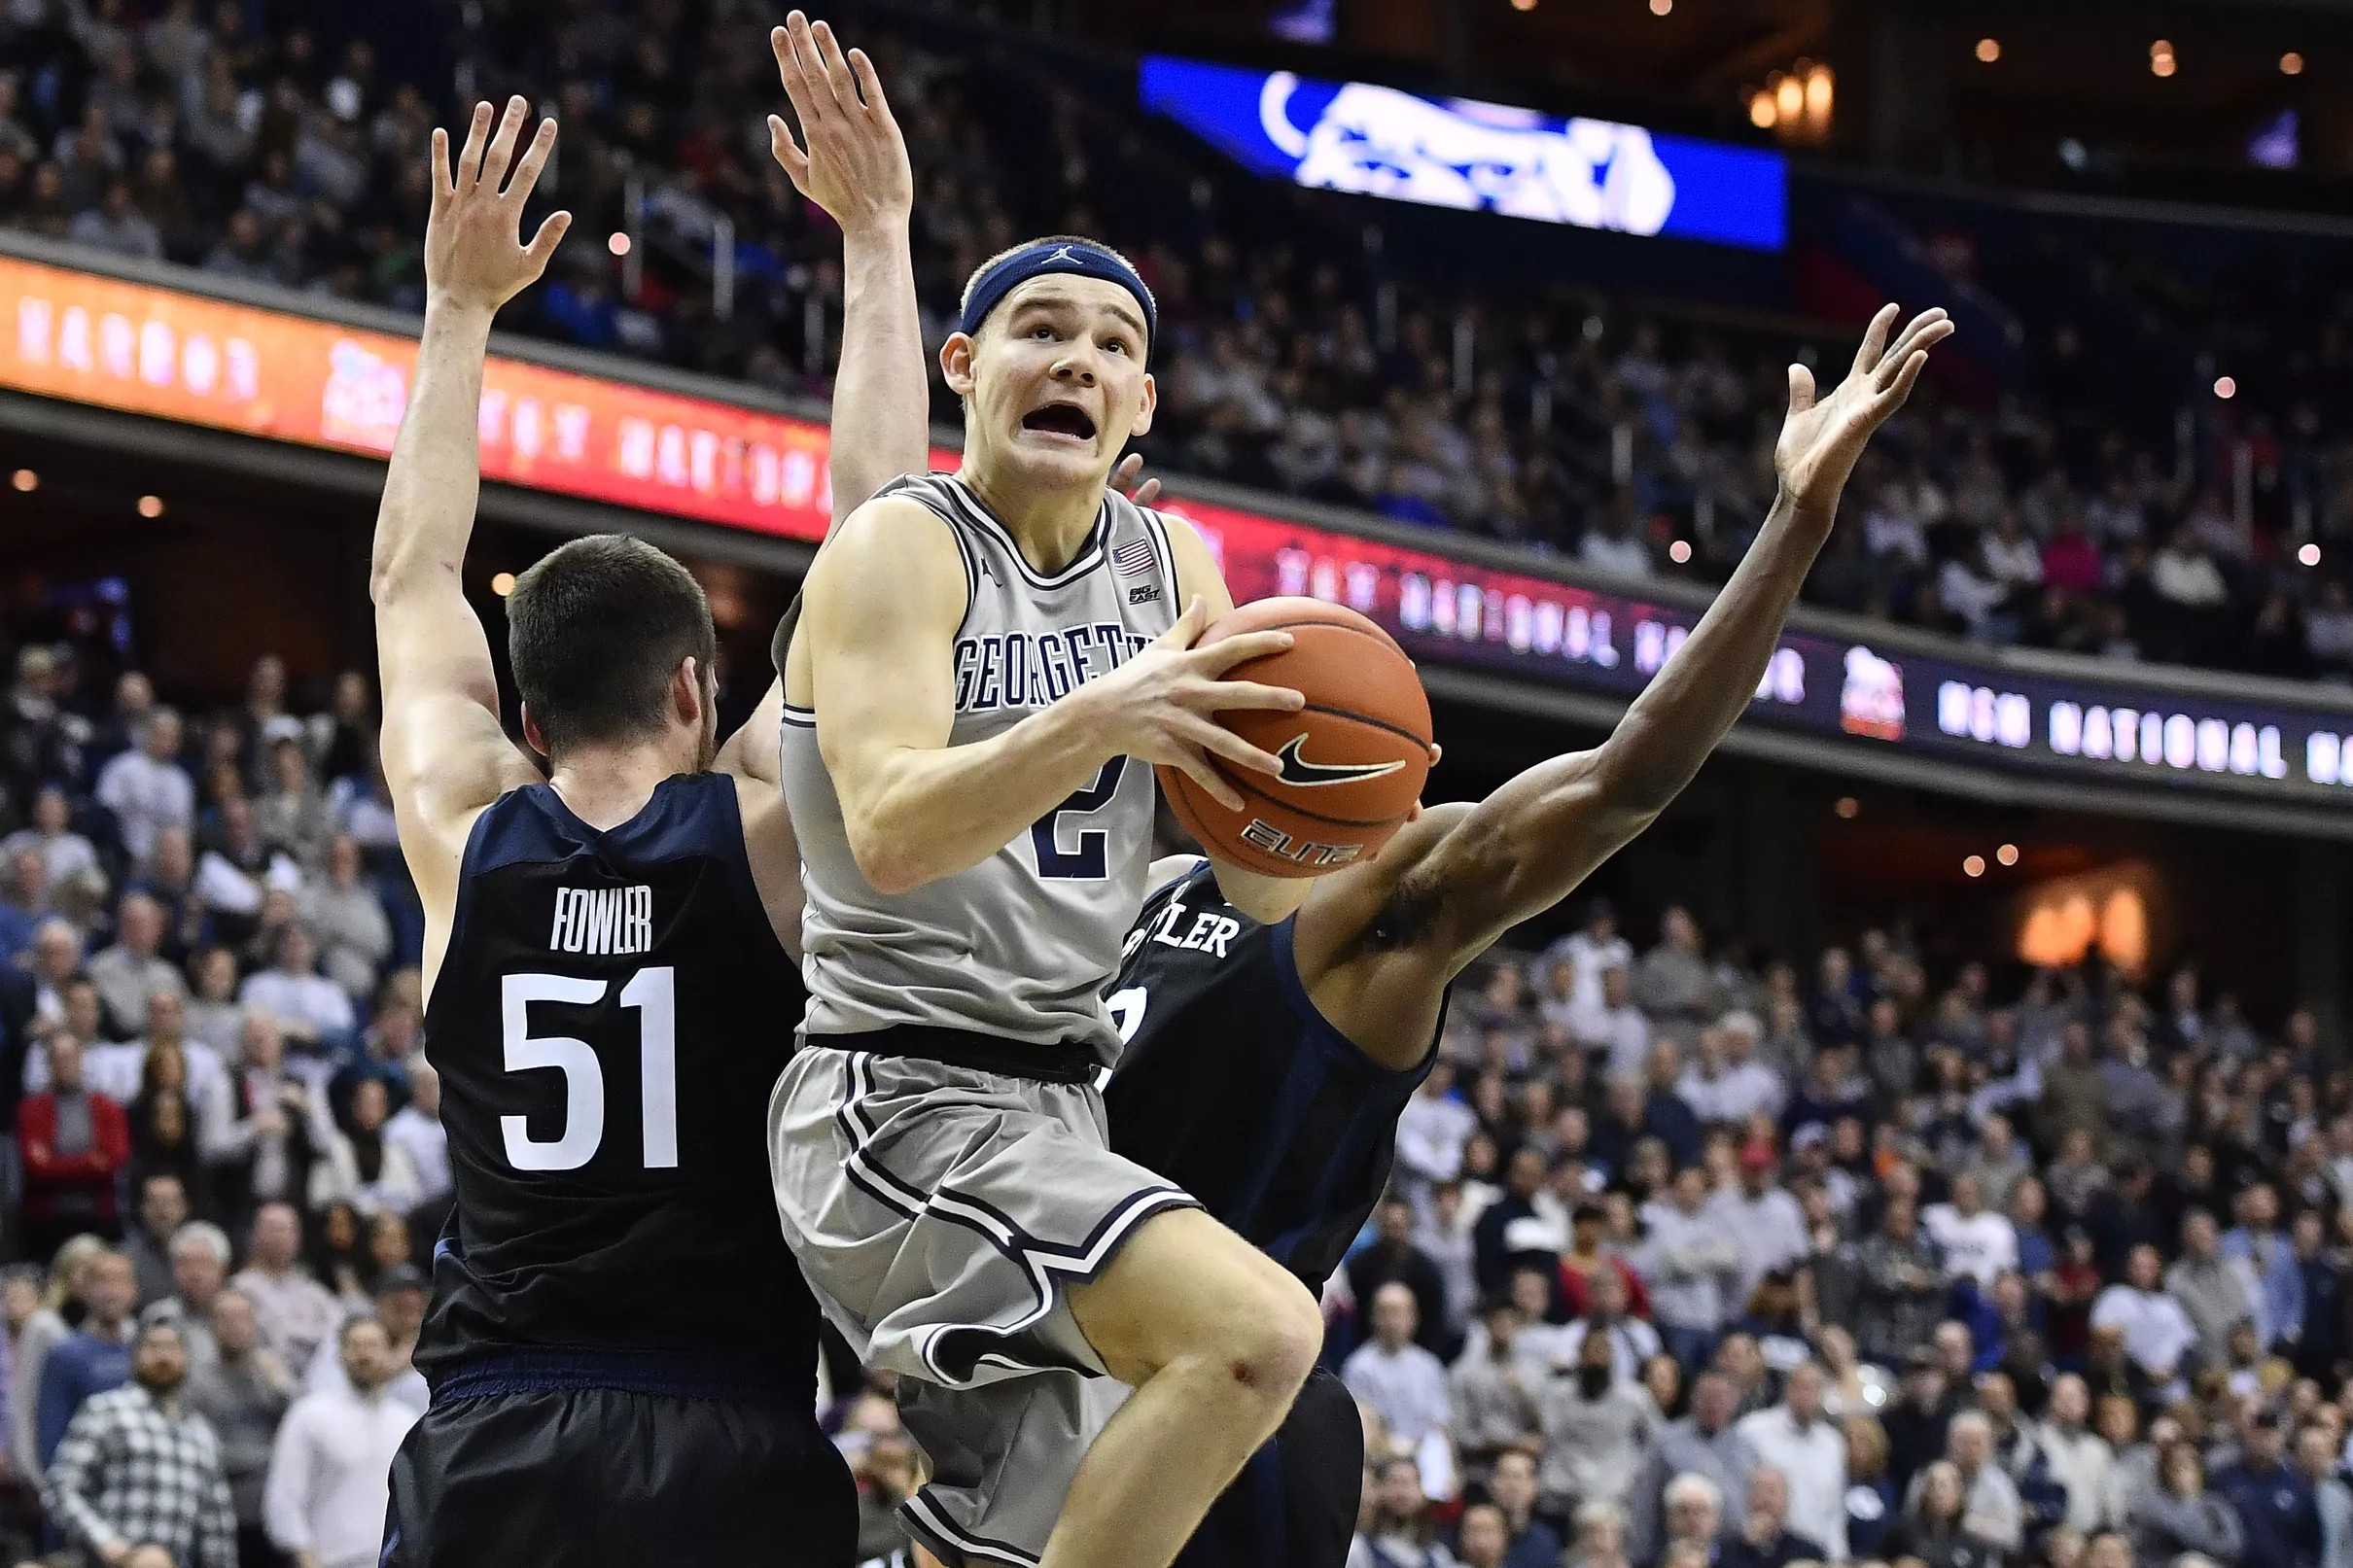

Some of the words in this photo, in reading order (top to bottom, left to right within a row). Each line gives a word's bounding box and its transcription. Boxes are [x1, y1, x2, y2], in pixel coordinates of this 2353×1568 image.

[1128, 589, 1161, 603] EAST
[1129, 584, 1152, 595] BIG
[2049, 700, 2288, 779] NATIONAL
[1028, 755, 1129, 881] 2
[1240, 818, 1363, 865] ELITE
[550, 885, 652, 955] FOWLER
[500, 966, 679, 1171] 51
